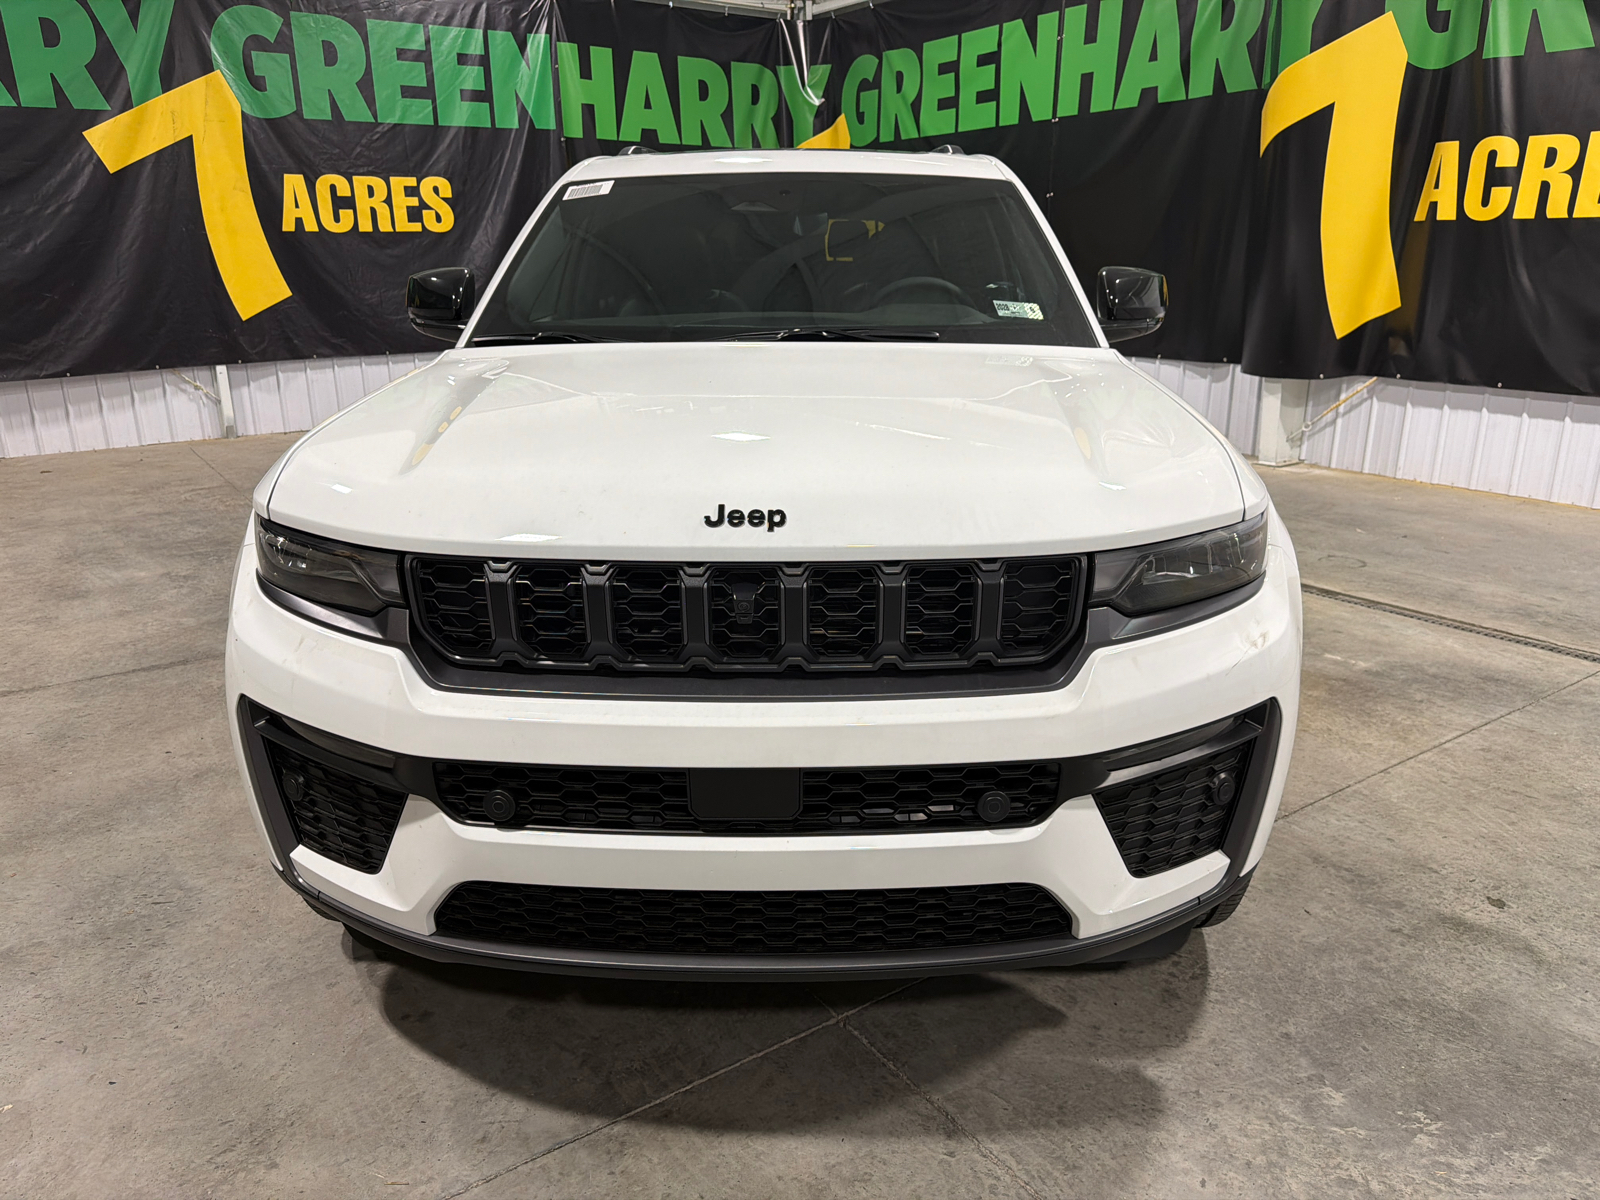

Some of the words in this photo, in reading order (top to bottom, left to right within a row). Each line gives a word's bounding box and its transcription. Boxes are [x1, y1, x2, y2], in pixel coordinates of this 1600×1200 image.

[210, 4, 557, 130] GREEN
[556, 41, 832, 149] HARRY
[842, 11, 1060, 147] GREEN
[1056, 0, 1324, 118] HAR
[82, 69, 293, 321] 7
[282, 173, 456, 233] ACRES
[1260, 10, 1408, 339] 7
[703, 503, 788, 533] Jeep
